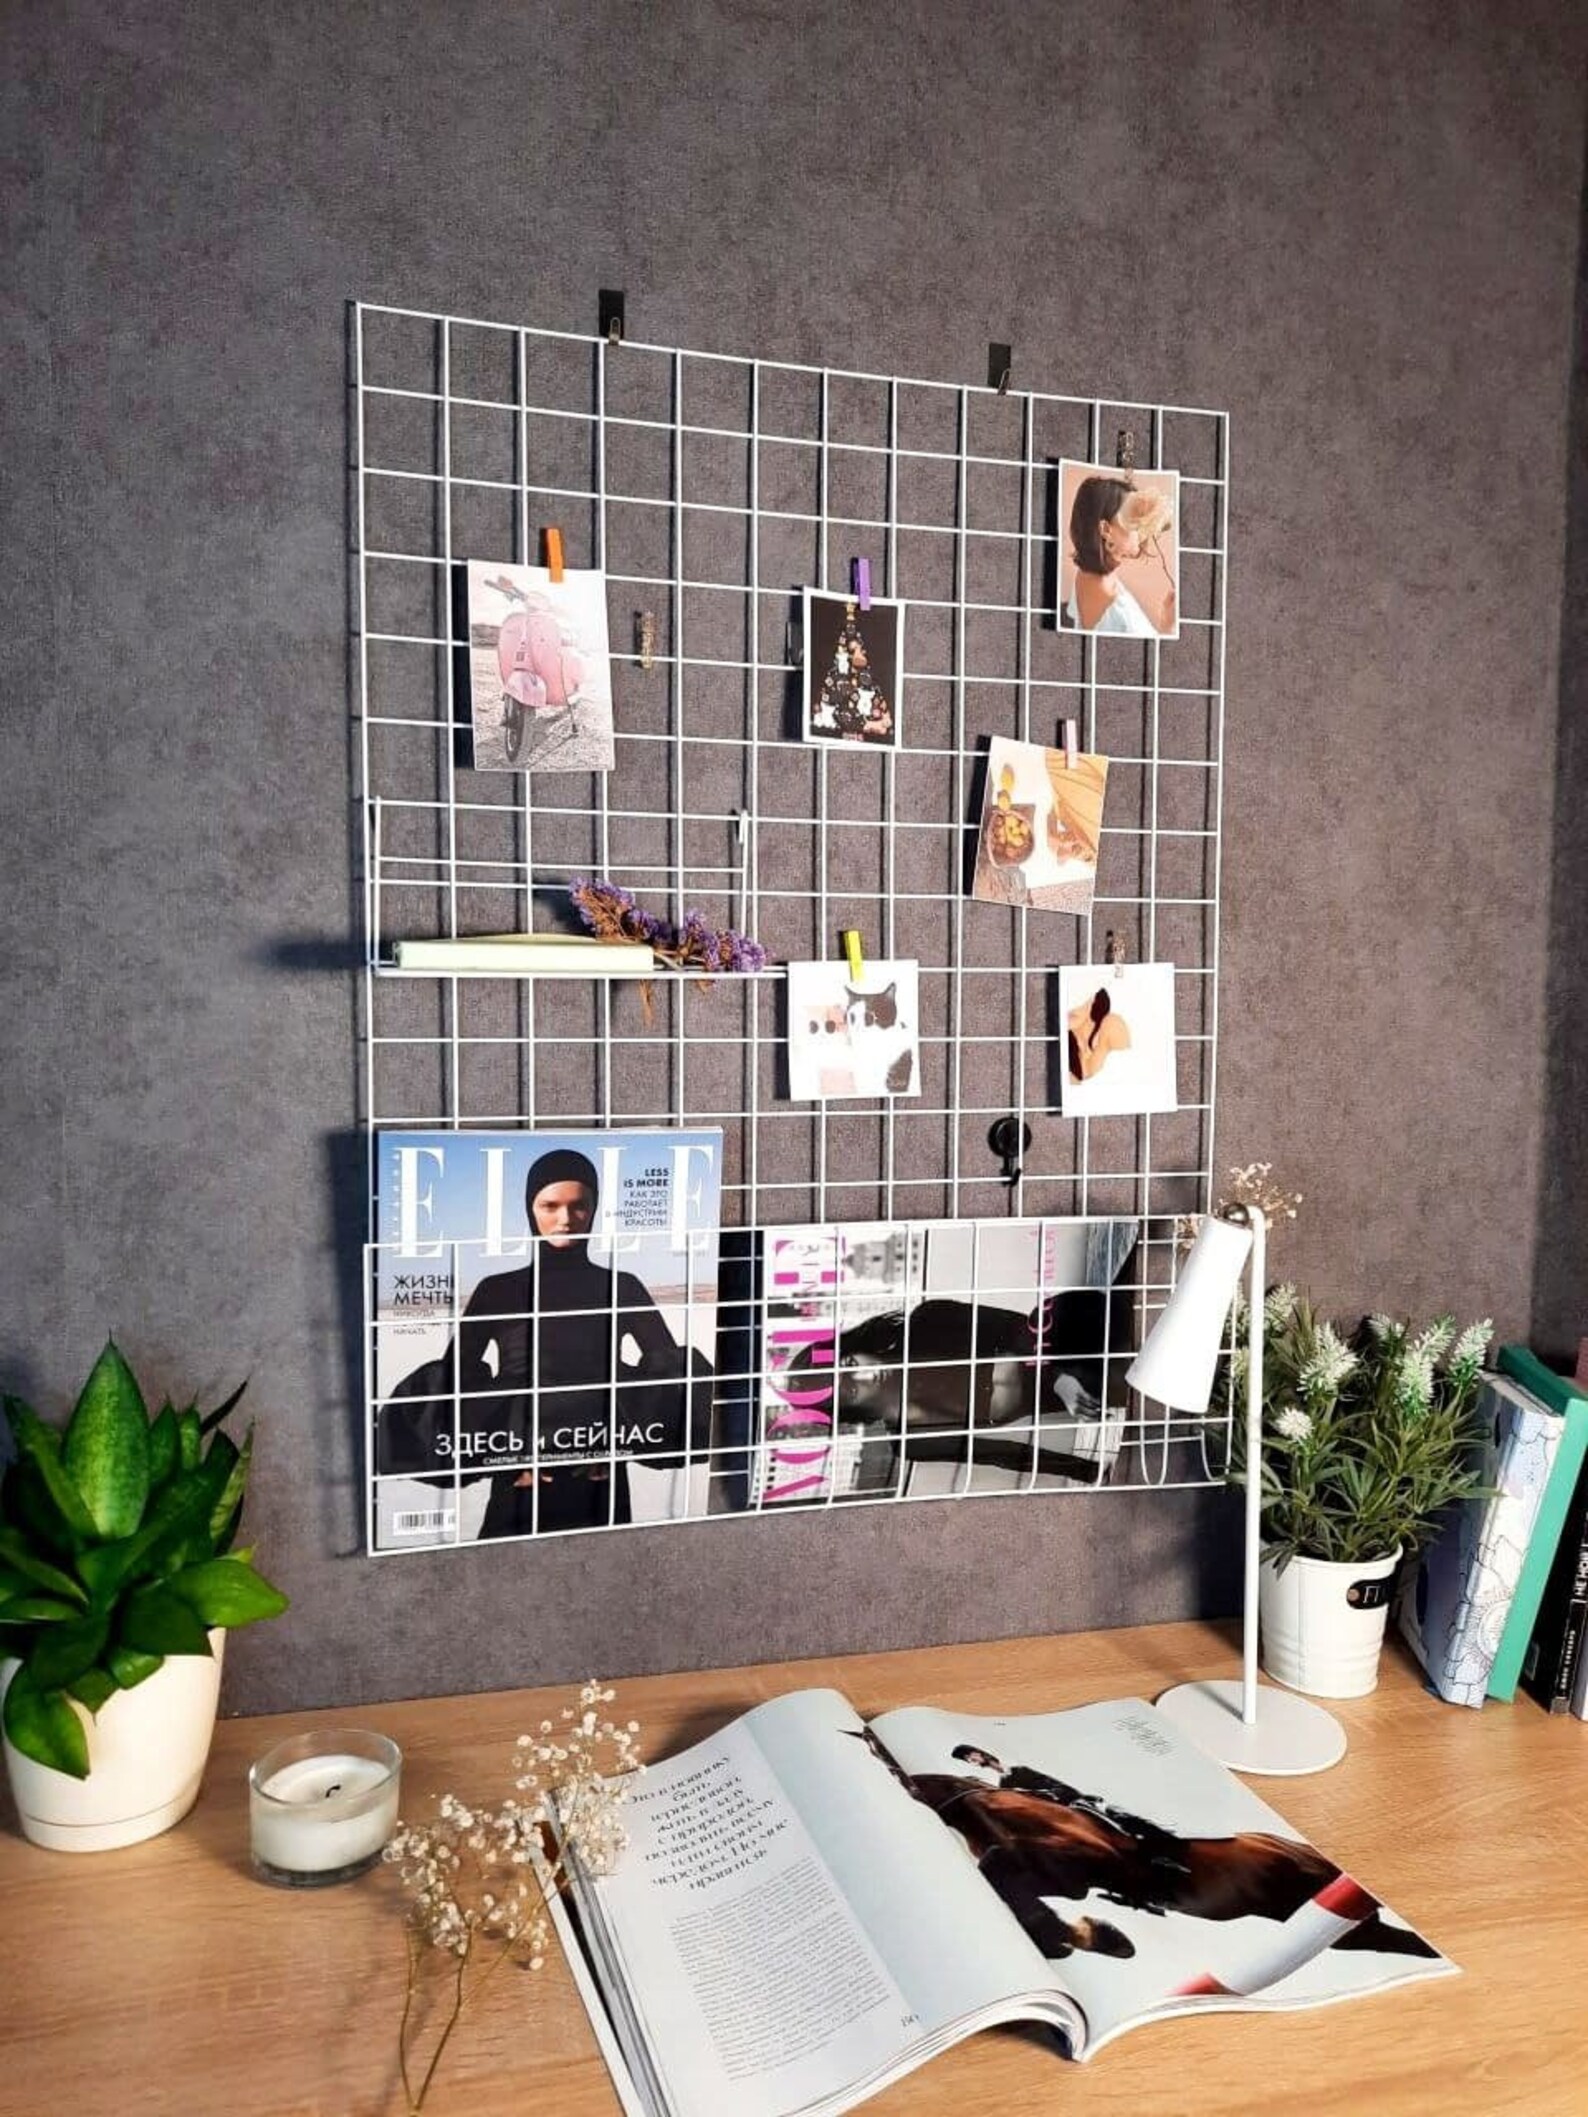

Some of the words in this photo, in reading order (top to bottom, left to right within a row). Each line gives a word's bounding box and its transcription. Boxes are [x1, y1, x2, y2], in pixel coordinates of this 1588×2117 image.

[644, 1168, 669, 1177] LESS
[623, 1179, 634, 1188] IS
[636, 1178, 668, 1187] MORE
[393, 1144, 714, 1258] ELLE
[435, 1430, 524, 1458] ЗДЕСЬ
